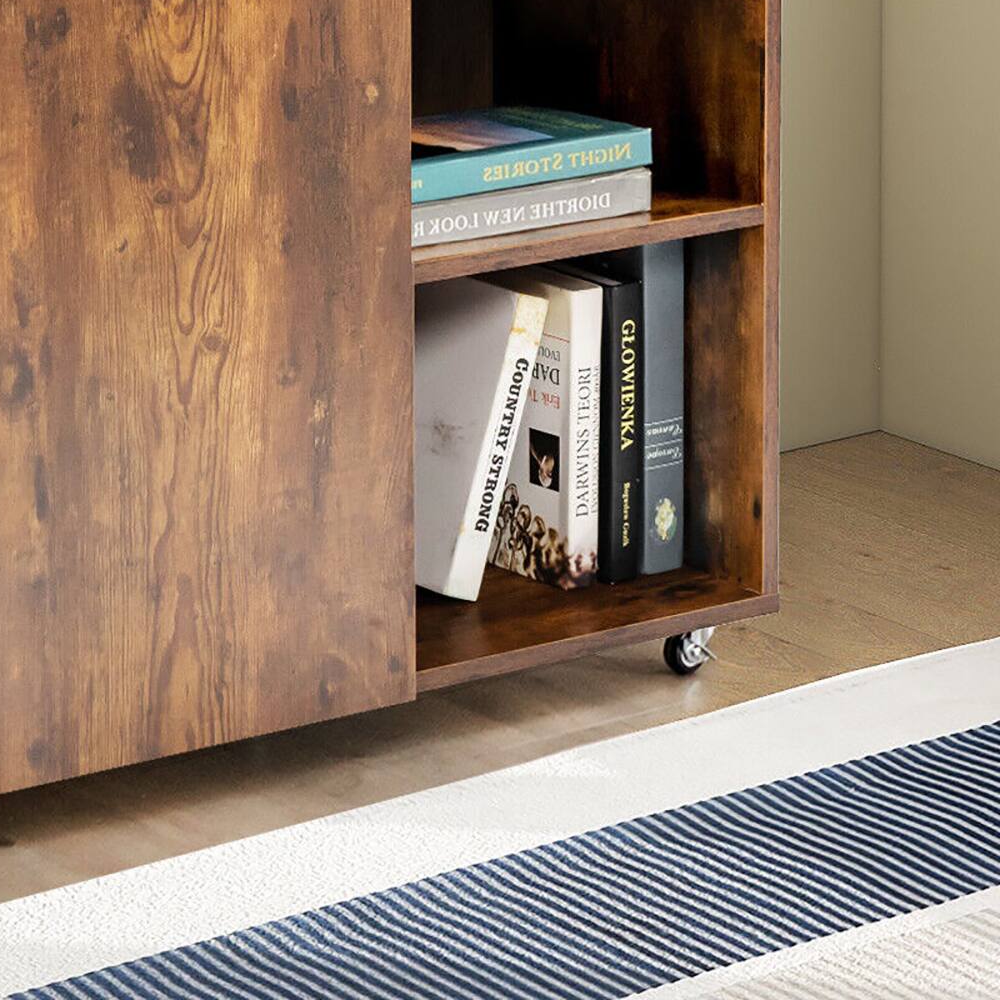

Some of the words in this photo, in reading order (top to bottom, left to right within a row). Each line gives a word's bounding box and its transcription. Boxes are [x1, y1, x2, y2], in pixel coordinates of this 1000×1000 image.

[494, 357, 530, 459] COUNTRY
[577, 367, 592, 425] TEORI
[474, 454, 506, 534] STRONG
[575, 428, 590, 518] DARWINS
